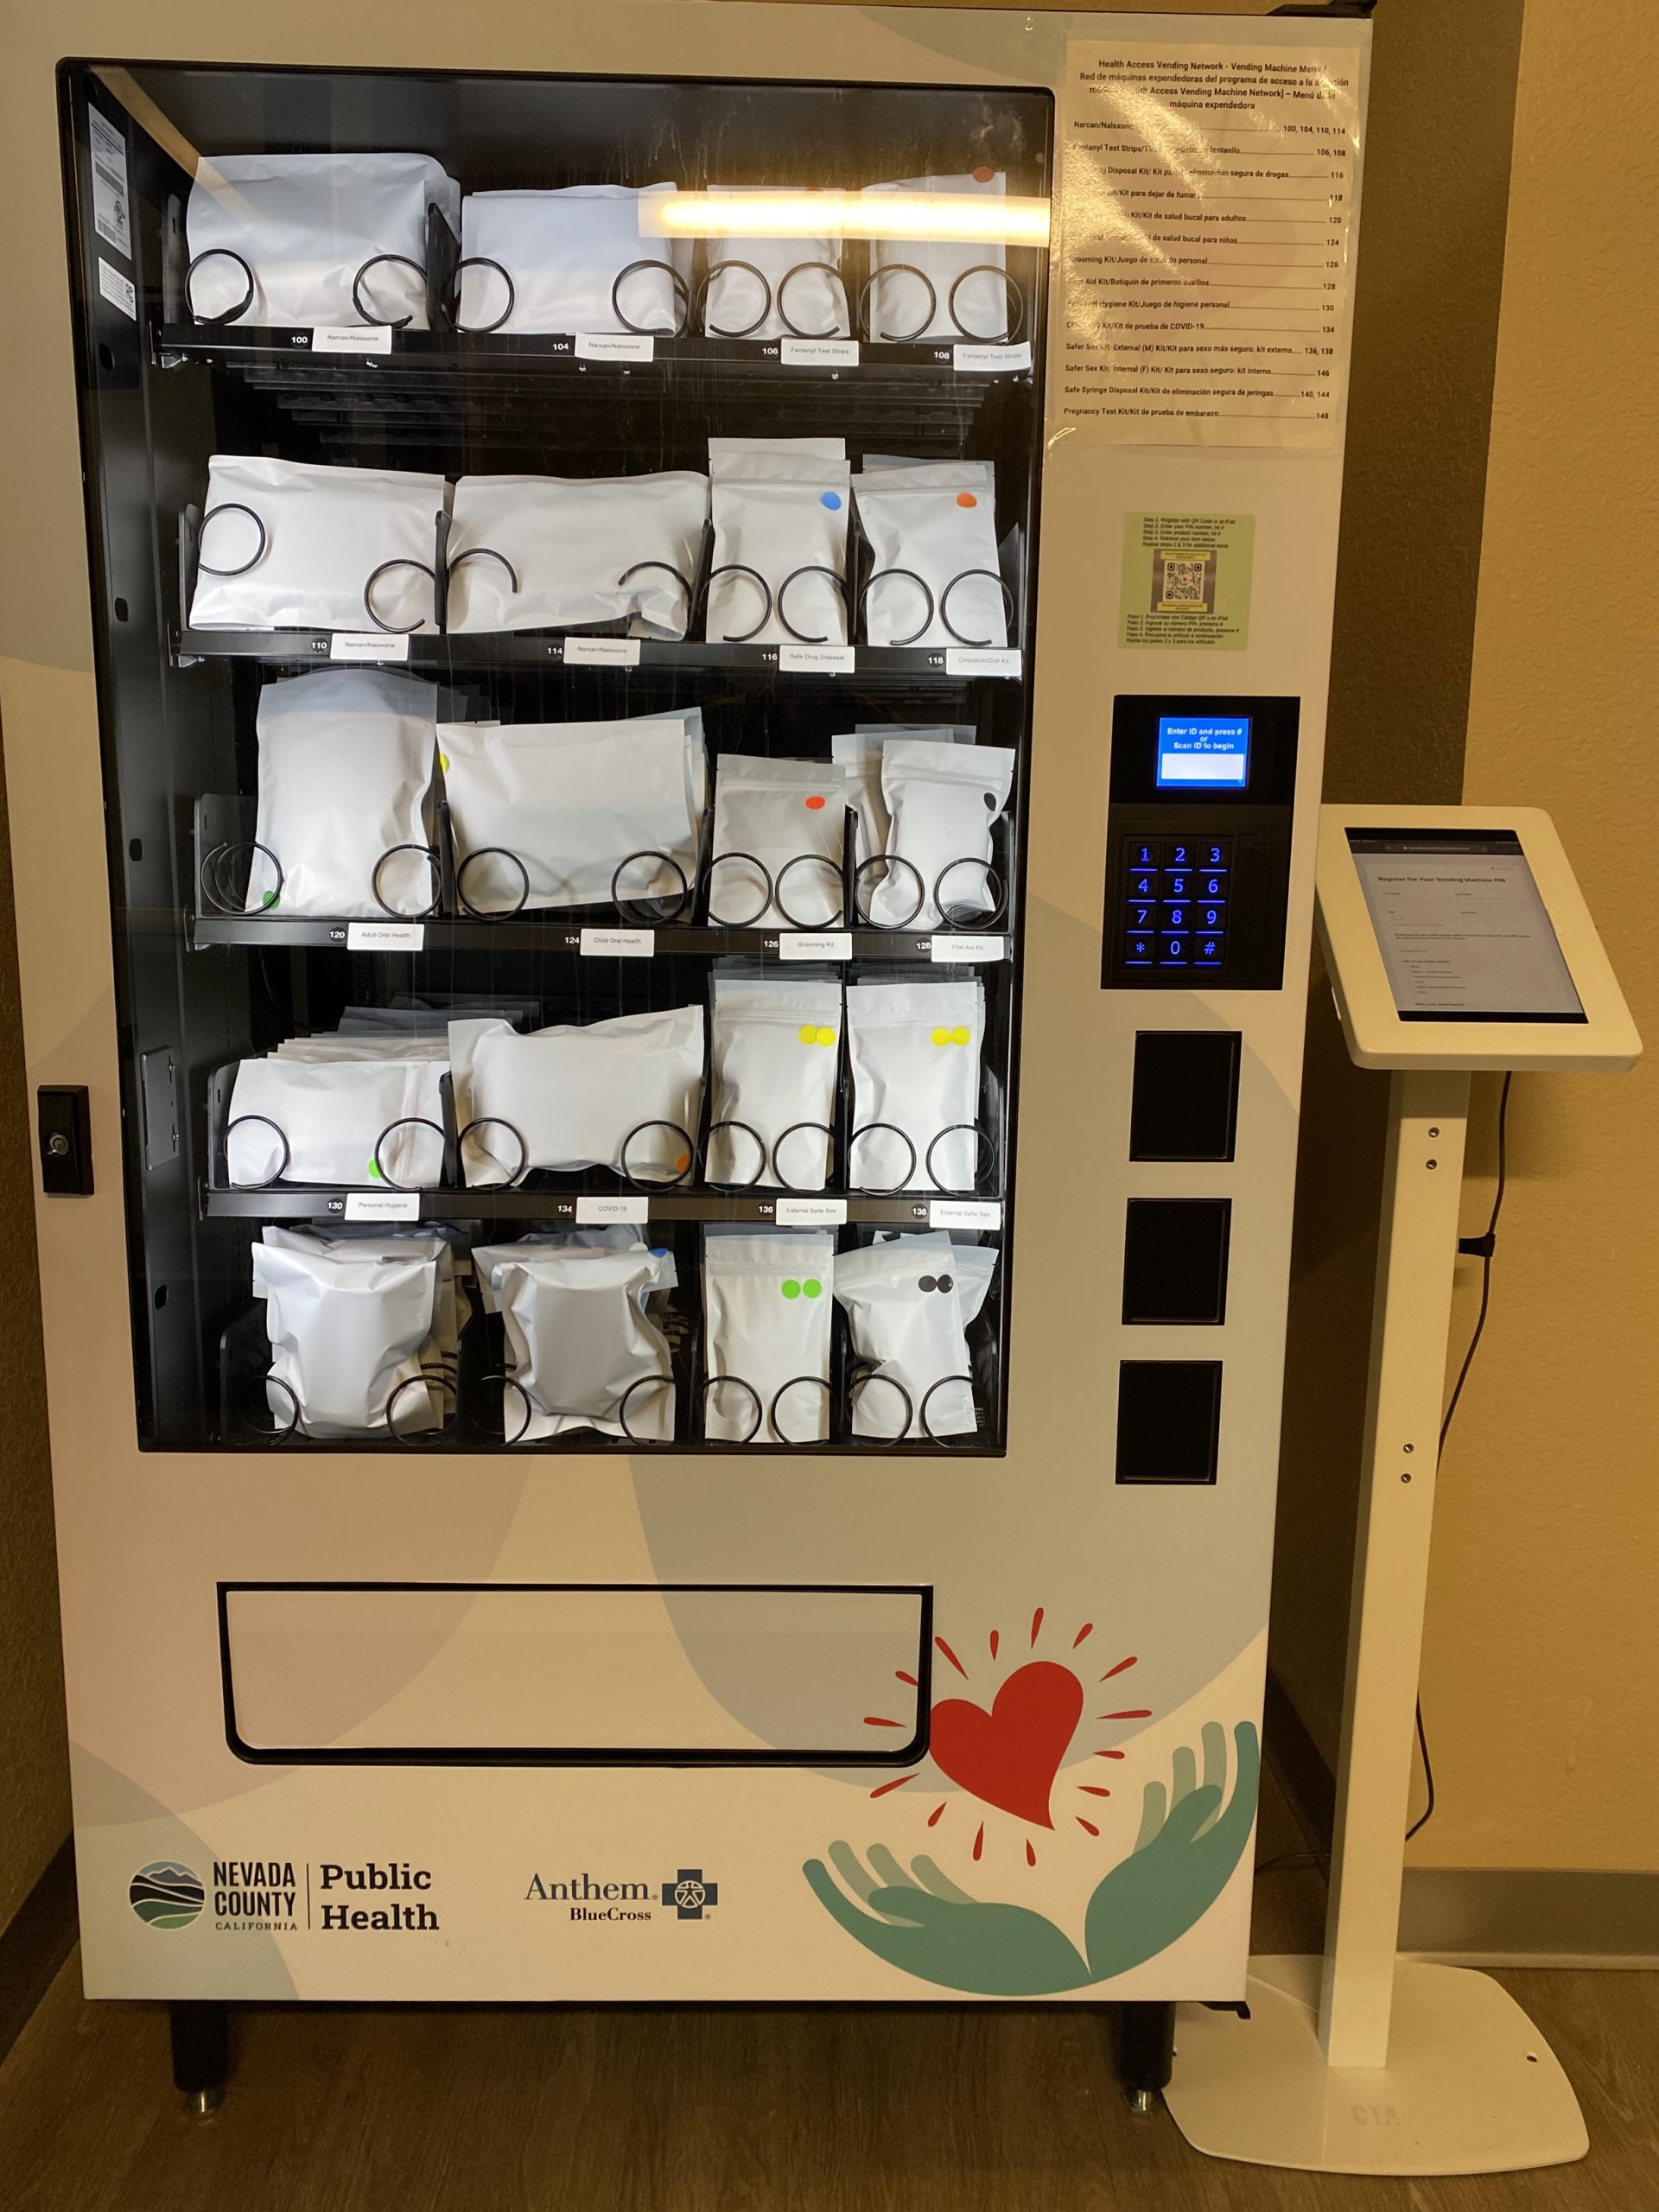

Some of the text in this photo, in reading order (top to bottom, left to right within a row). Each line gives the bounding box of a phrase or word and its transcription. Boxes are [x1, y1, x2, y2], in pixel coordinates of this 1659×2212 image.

[1099, 60, 1124, 68] Health
[1157, 61, 1188, 71] Vending
[1230, 63, 1262, 72] Vending
[1264, 64, 1297, 73] Machine
[1109, 73, 1147, 82] máquinas
[1148, 74, 1203, 83] expendedoras
[1205, 74, 1217, 83] del
[1219, 76, 1256, 86] programa
[1306, 78, 1313, 86] la
[1180, 87, 1212, 97] Vending
[1249, 89, 1284, 99] Network]
[1170, 100, 1255, 111] máquina expendedora
[1317, 149, 1331, 157] 106,
[1082, 386, 1107, 395] Syringe
[1064, 408, 1099, 416] Pregnancy
[1213, 742, 1234, 751] begin
[1141, 848, 1220, 862] 1 2 3
[1138, 878, 1218, 893] 4 5 6
[1137, 910, 1217, 925] 7 8 9
[1171, 941, 1216, 955] 0 #
[213, 1861, 296, 1887] NEVADA
[321, 1863, 431, 1890] Public
[524, 1873, 651, 1901] Anthem
[214, 1891, 296, 1916] COUNTY
[321, 1904, 440, 1930] Health
[569, 1907, 652, 1921] BlueCross
[215, 1922, 297, 1931] CALIFORNIA
